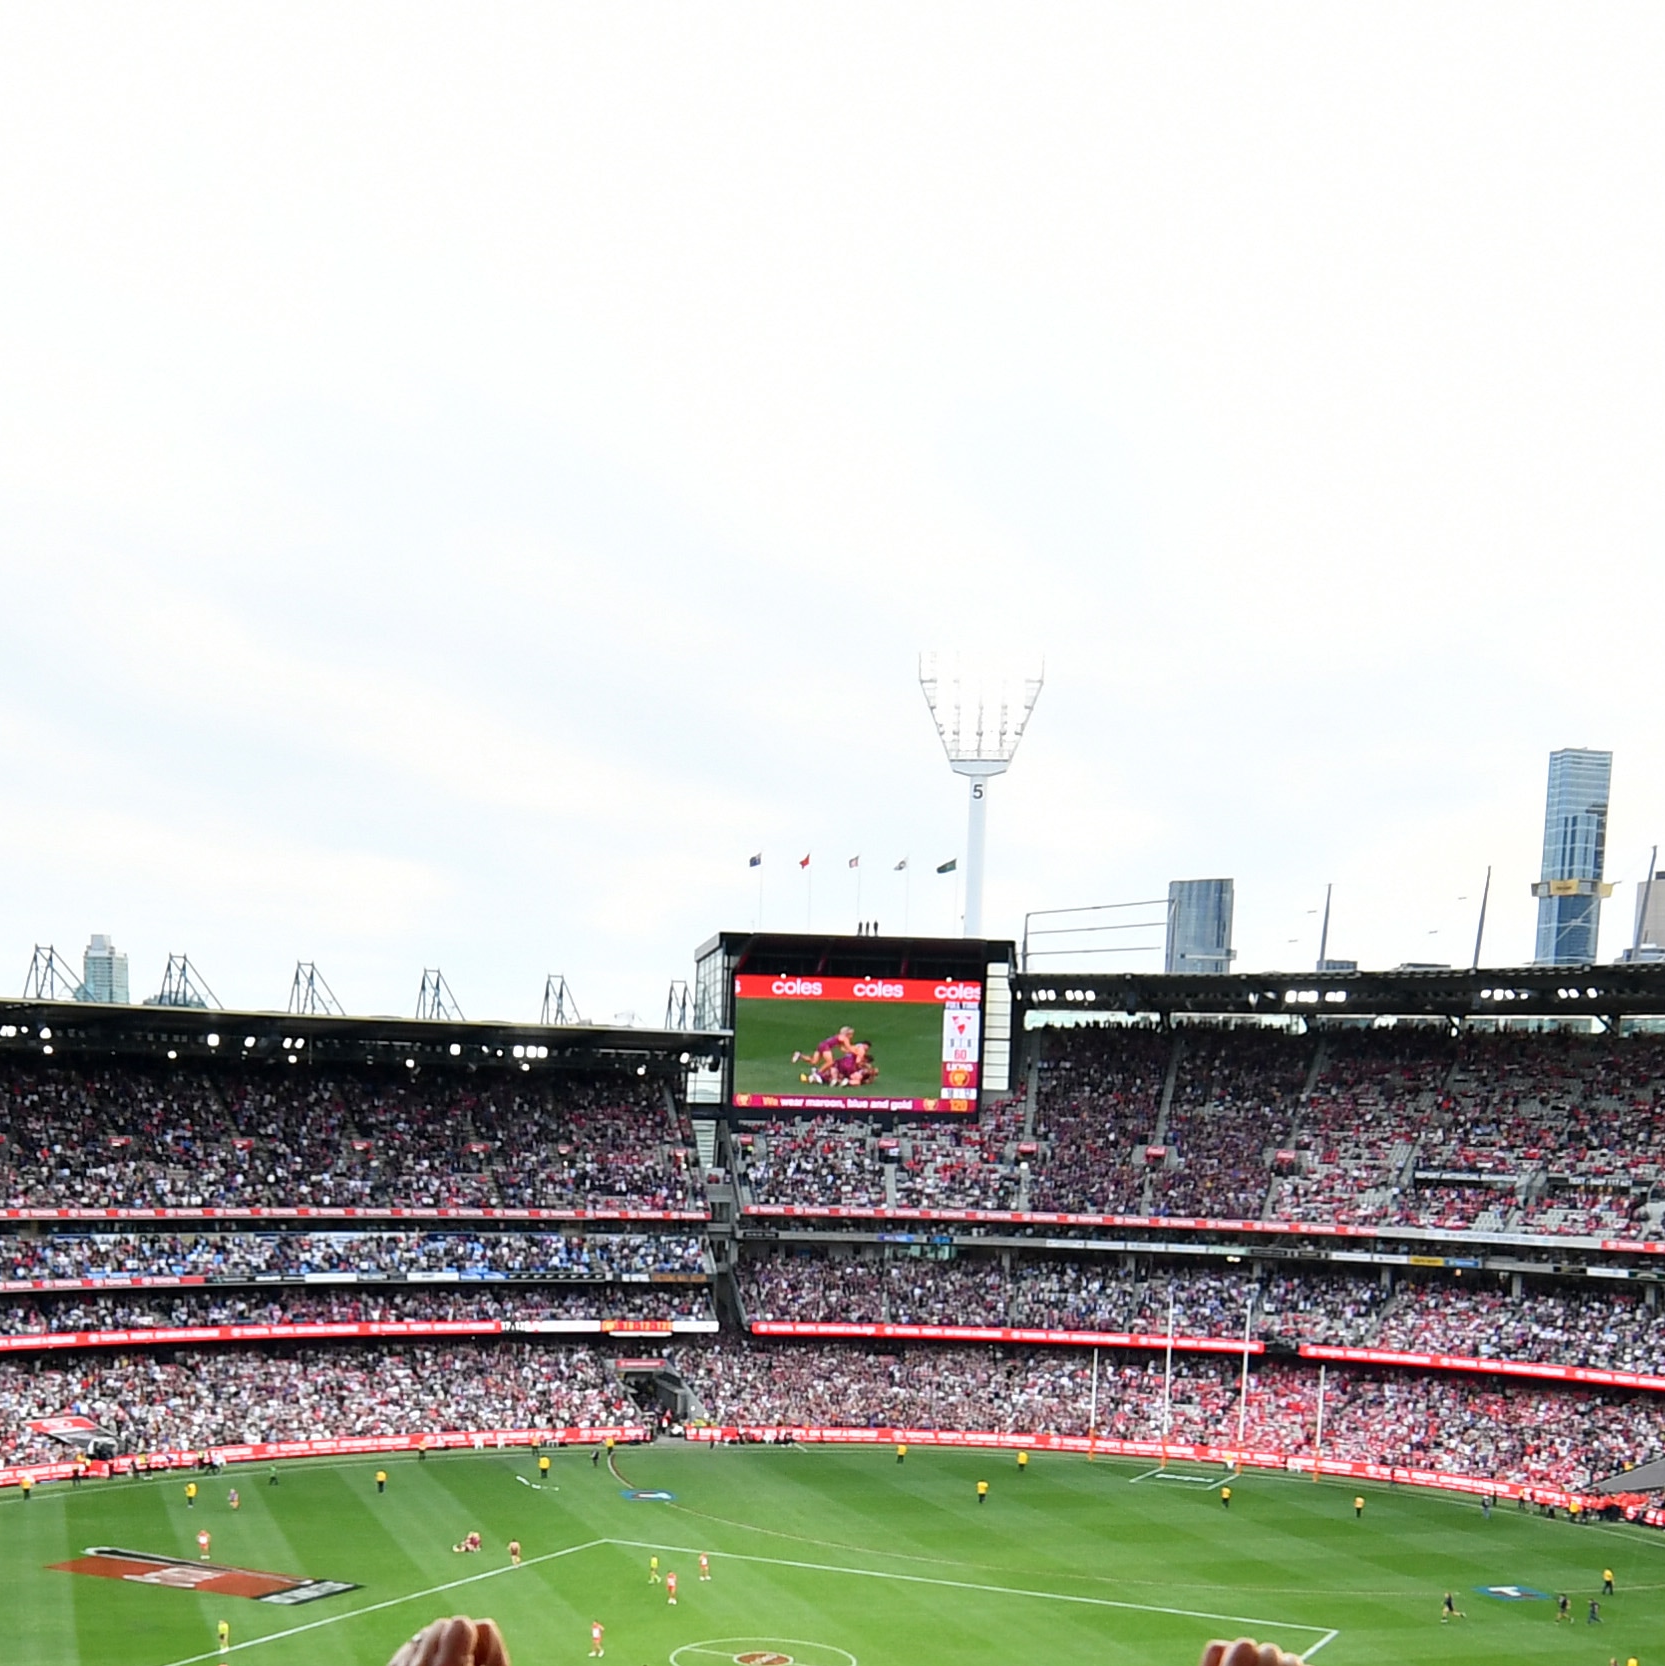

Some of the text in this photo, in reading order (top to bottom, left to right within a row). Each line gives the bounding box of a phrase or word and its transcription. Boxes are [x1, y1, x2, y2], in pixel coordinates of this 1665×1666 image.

[972, 784, 984, 800] 5
[772, 978, 823, 996] coles
[853, 980, 904, 998] coles
[780, 1099, 804, 1107] wear
[806, 1099, 846, 1109] maroon,
[847, 1099, 868, 1109] blue
[870, 1099, 888, 1109] and
[890, 1100, 913, 1111] gold
